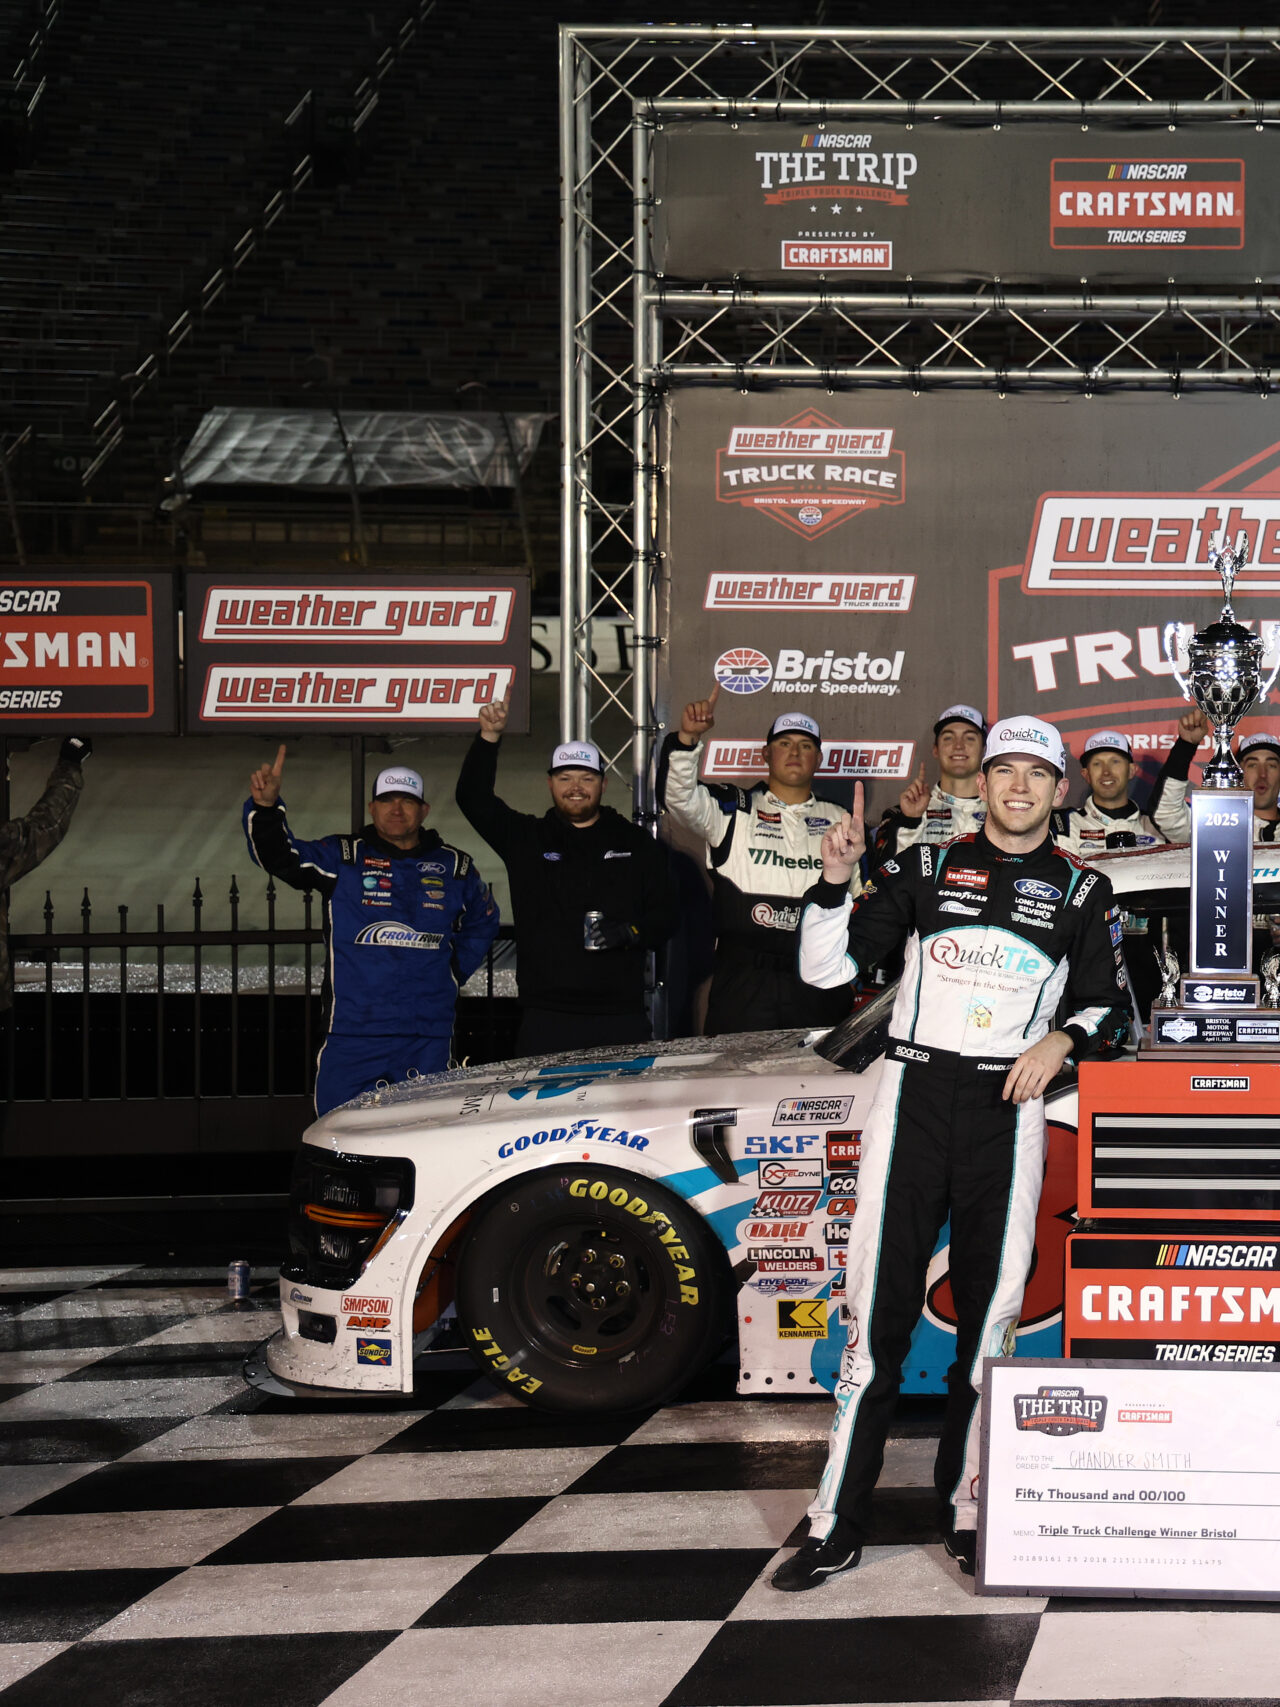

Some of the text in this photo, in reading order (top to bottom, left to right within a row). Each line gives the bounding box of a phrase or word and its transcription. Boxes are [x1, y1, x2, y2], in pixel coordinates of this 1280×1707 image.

[818, 134, 872, 148] NASCAR
[755, 152, 918, 189] THE TRIP
[1127, 164, 1188, 179] NASCAR
[1059, 192, 1234, 216] CRAFTSMAN
[1107, 230, 1187, 243] TRUCK SERIES
[789, 248, 885, 264] CRAFTSMAN
[735, 431, 886, 453] weather guard
[723, 464, 898, 489] TRUCK RACE
[715, 577, 905, 606] weather guard
[216, 594, 498, 635] weather guard
[774, 649, 905, 681] Bristol
[217, 672, 498, 713] weather guard
[771, 680, 898, 697] Motor Speedway
[999, 728, 1049, 744] QuickTie
[827, 746, 904, 772] guard
[1205, 813, 1239, 826] 2025
[922, 846, 932, 876] sparco
[948, 873, 986, 883] CRAFTSMAN
[938, 890, 988, 902] GOODYEAR
[1021, 882, 1055, 898] Ford
[1072, 874, 1096, 906] sparco
[1015, 897, 1056, 912] LONG JOHN
[1214, 850, 1230, 957] WINNER
[1018, 905, 1052, 919] SILVER'S
[930, 936, 1040, 975] QuickTie
[984, 981, 995, 989] the
[896, 1046, 930, 1060] sparco
[1194, 1079, 1246, 1088] CRAFTSMAN
[801, 1100, 841, 1110] NASCAR
[780, 1112, 841, 1121] RACE TRUCK
[498, 1119, 650, 1158] GOODYEAR
[745, 1135, 819, 1154] SKF
[760, 1194, 815, 1210] KLOTZ
[569, 1178, 699, 1306] GOODYEAR
[751, 1249, 811, 1259] LINCOLN
[1185, 1244, 1278, 1267] NASCAR
[765, 1262, 817, 1270] WELDERS
[344, 1298, 389, 1313] SIMPSON
[347, 1316, 391, 1328] ARP
[472, 1327, 543, 1394] EAGLE
[1155, 1344, 1276, 1363] TRUCK SERIES
[1018, 1399, 1103, 1419] THE TRIP
[1120, 1412, 1171, 1421] CRAFTSMAN
[1070, 1450, 1192, 1469] CHANDLER SMITH
[1015, 1488, 1186, 1501] Fifty Thousand and 00/100
[1038, 1525, 1069, 1536] Triple
[1072, 1526, 1101, 1535] Truck
[1104, 1527, 1156, 1538] Challenge
[1160, 1528, 1197, 1537] Winner
[1201, 1529, 1237, 1538] Bristol
